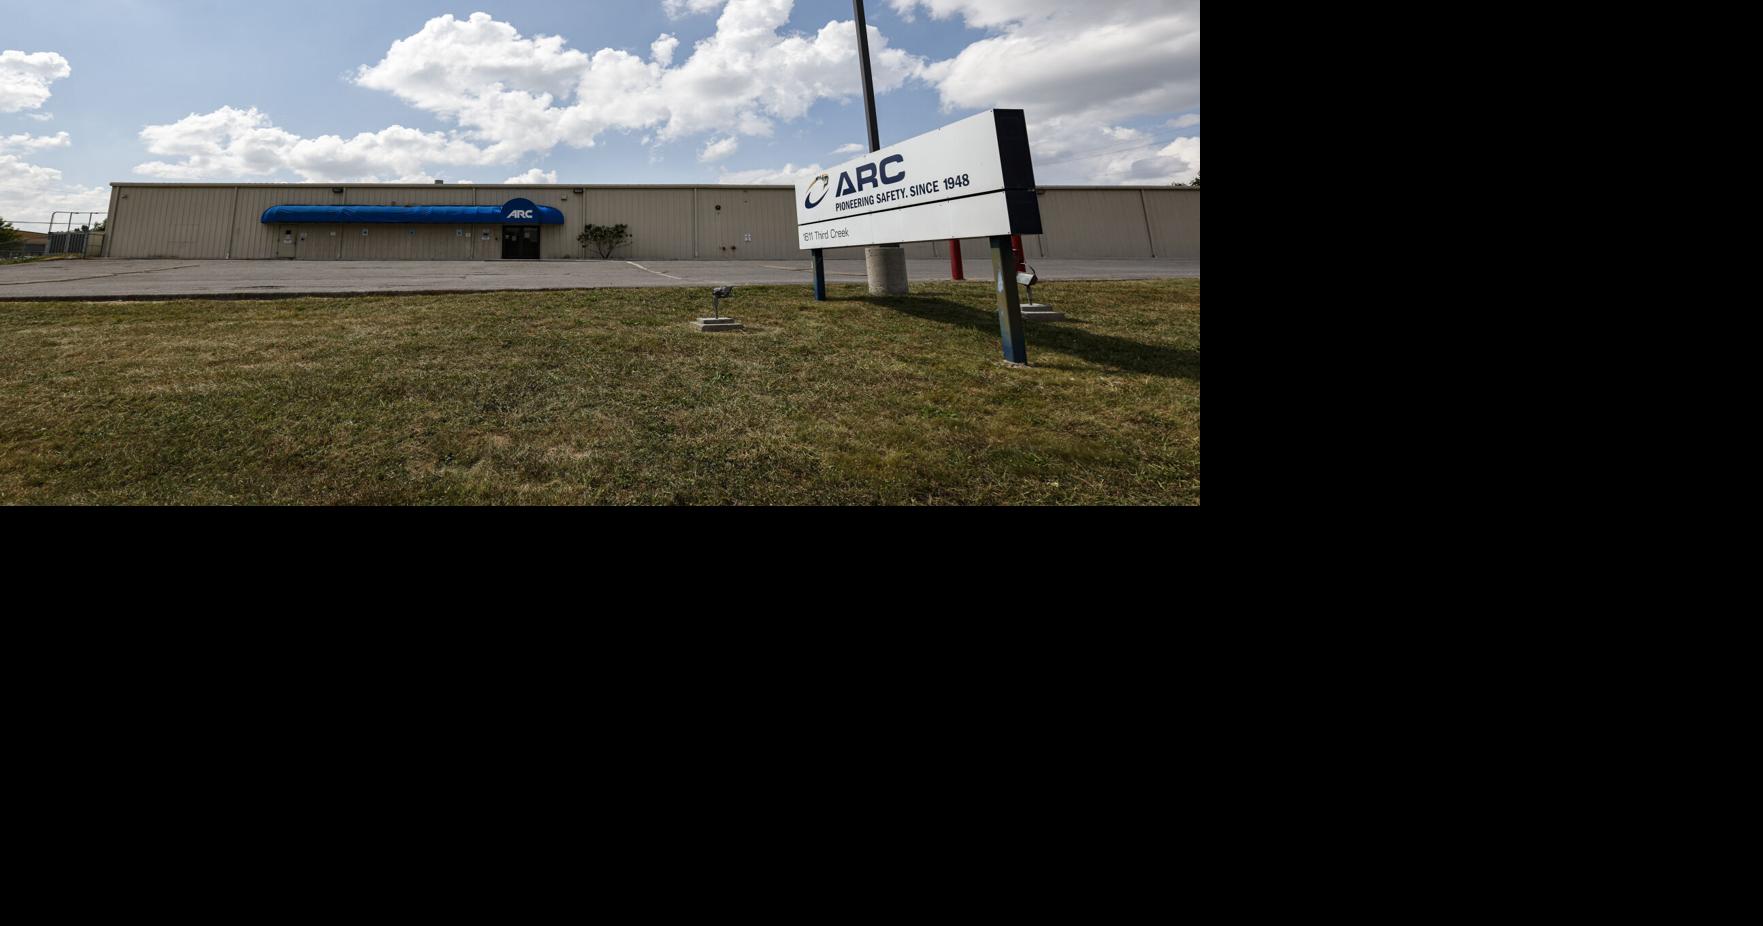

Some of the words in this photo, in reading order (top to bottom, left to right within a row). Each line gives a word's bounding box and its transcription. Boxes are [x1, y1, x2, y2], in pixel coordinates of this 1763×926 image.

[835, 154, 905, 197] ARC
[835, 195, 874, 211] PIONEERING
[876, 187, 908, 203] SAFETY.
[910, 180, 940, 197] SINCE
[943, 173, 970, 190] 1948
[506, 209, 533, 219] ARC
[814, 230, 829, 240] Third
[830, 227, 849, 239] Creek
